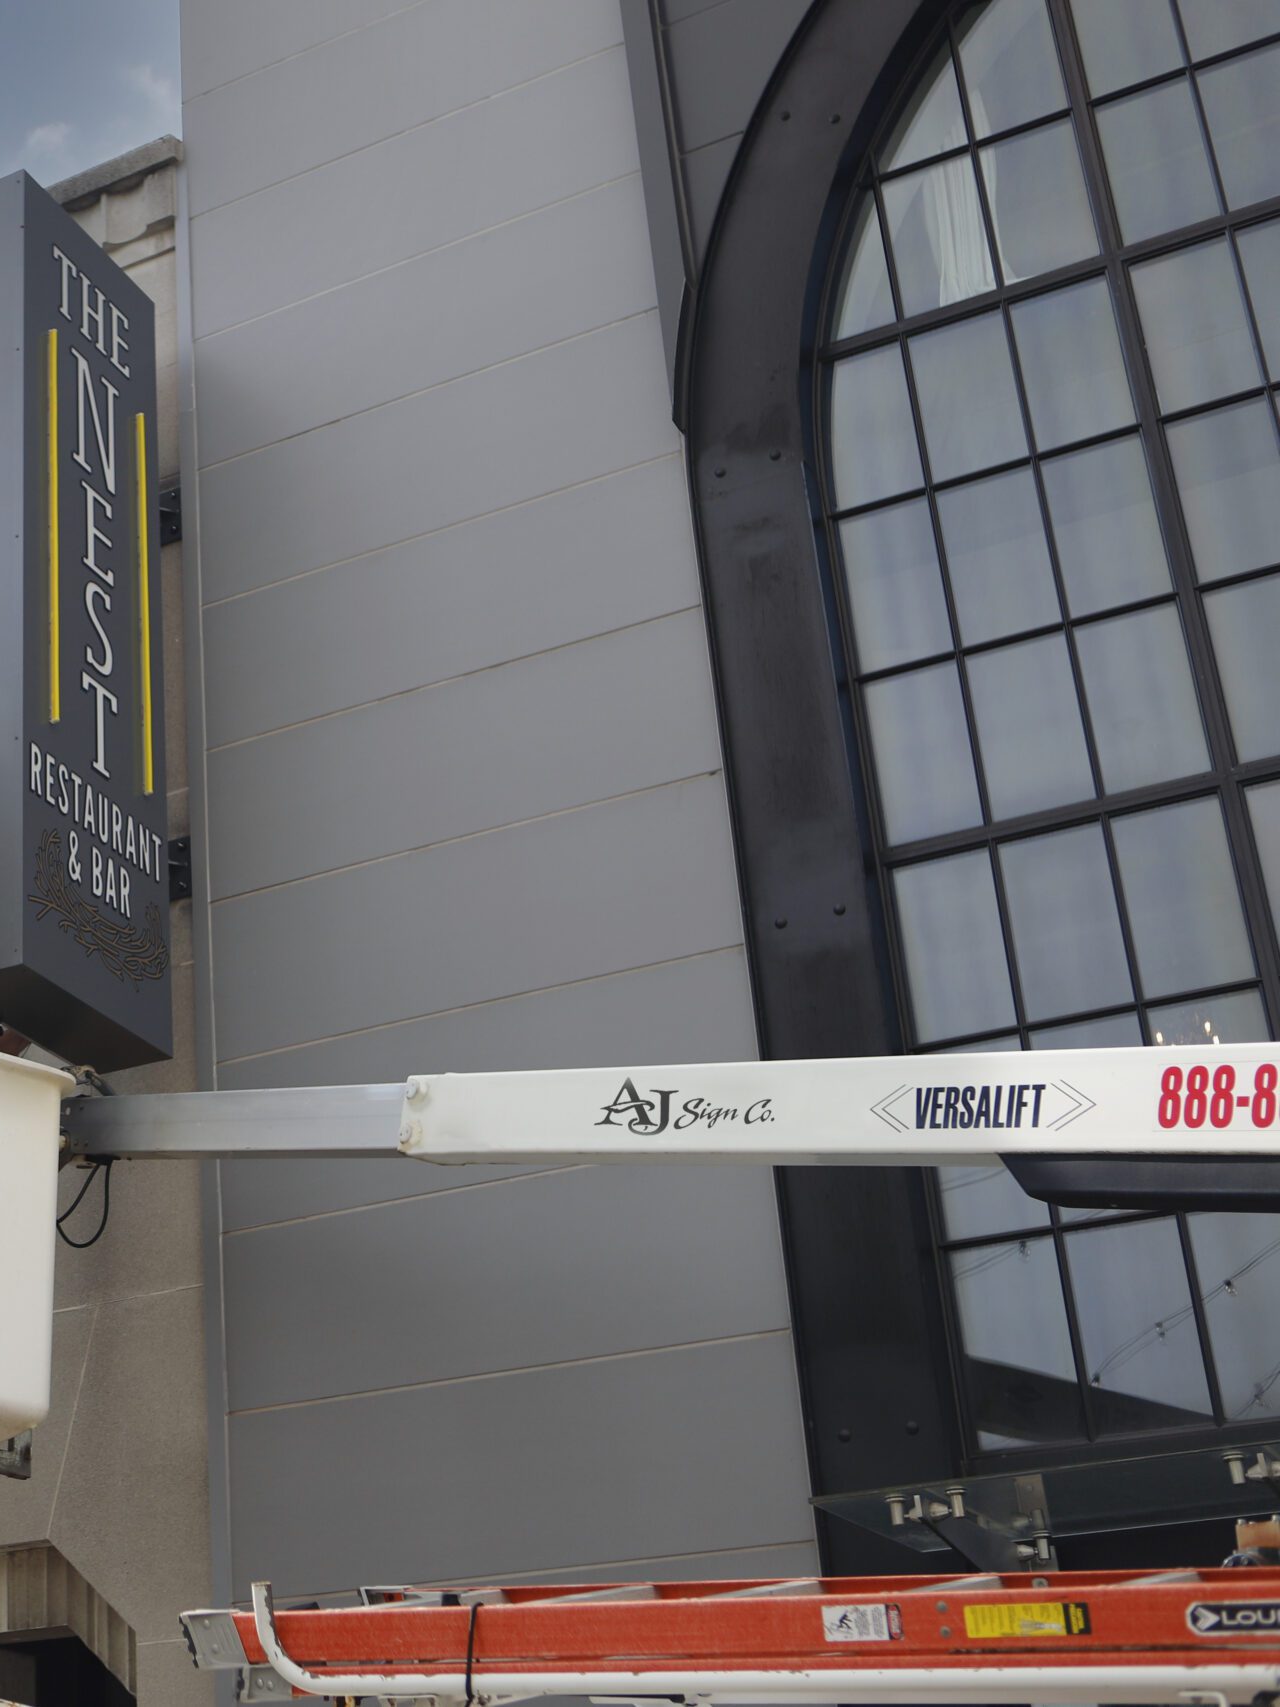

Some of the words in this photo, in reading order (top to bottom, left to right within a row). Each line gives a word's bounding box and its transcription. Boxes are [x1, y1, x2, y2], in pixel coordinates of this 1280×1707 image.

[53, 245, 130, 378] THE
[71, 347, 119, 778] NEST
[31, 742, 162, 882] RESTAURANT
[68, 830, 82, 883] &
[92, 846, 131, 918] BAR
[594, 1076, 679, 1136] AJ
[673, 1098, 738, 1130] Sign
[744, 1098, 776, 1125] Co.
[915, 1084, 1047, 1129] VERSALIFT
[1158, 1063, 1280, 1129] 888-8
